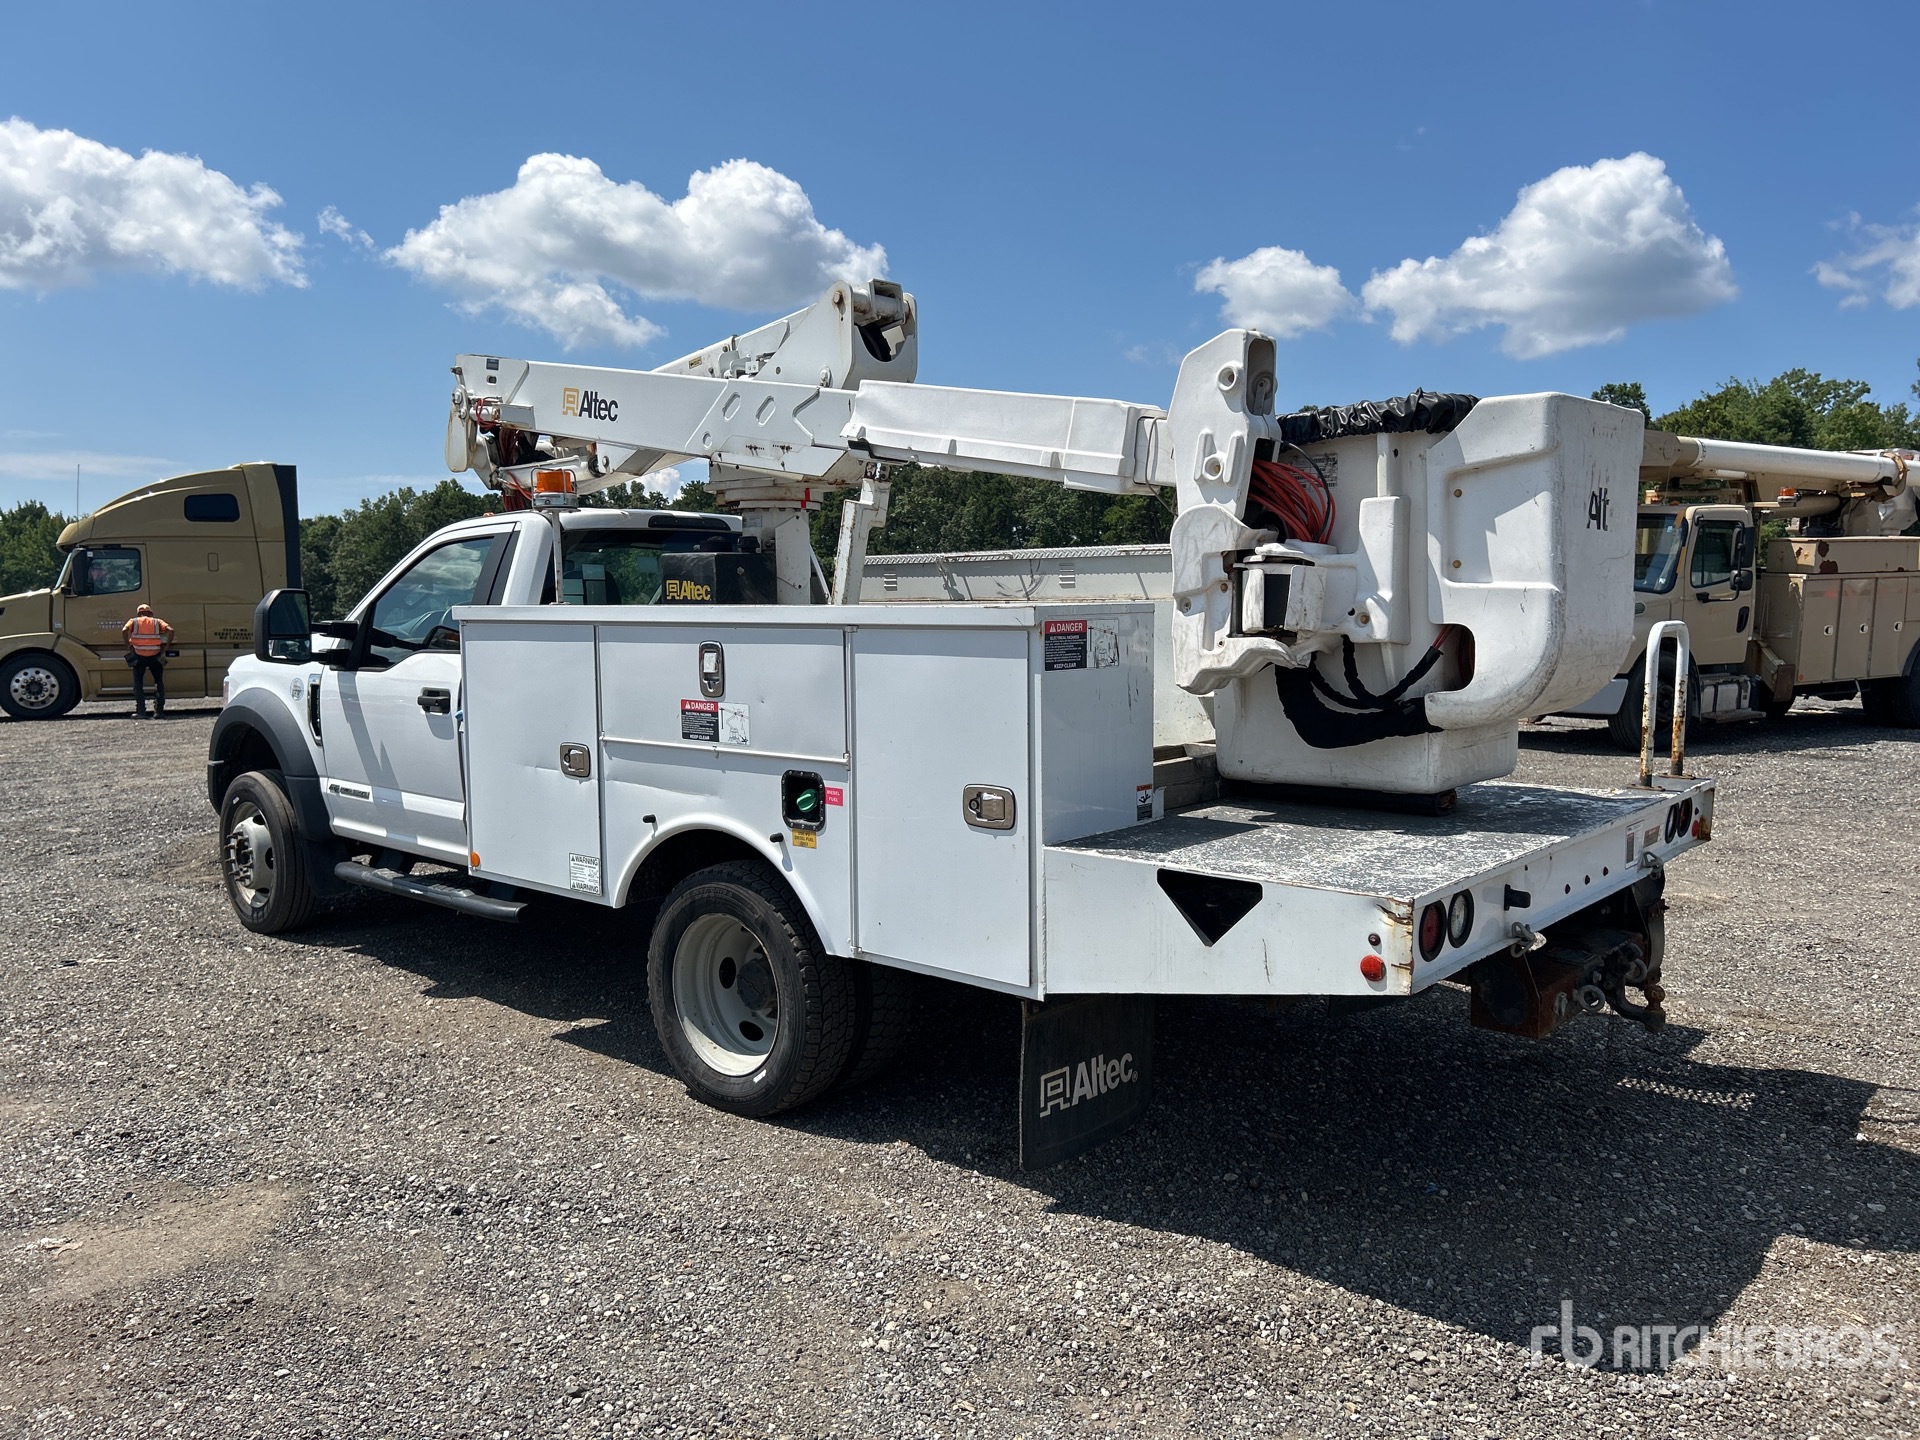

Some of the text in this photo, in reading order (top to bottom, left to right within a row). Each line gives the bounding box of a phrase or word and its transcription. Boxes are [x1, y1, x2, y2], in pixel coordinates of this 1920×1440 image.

[579, 390, 618, 422] Altec
[680, 580, 711, 600] Altec
[1056, 623, 1083, 632] DANGER
[690, 702, 715, 711] DANGER
[575, 856, 598, 866] WARNING
[576, 882, 598, 893] WARNING
[1071, 1052, 1133, 1107] Altec
